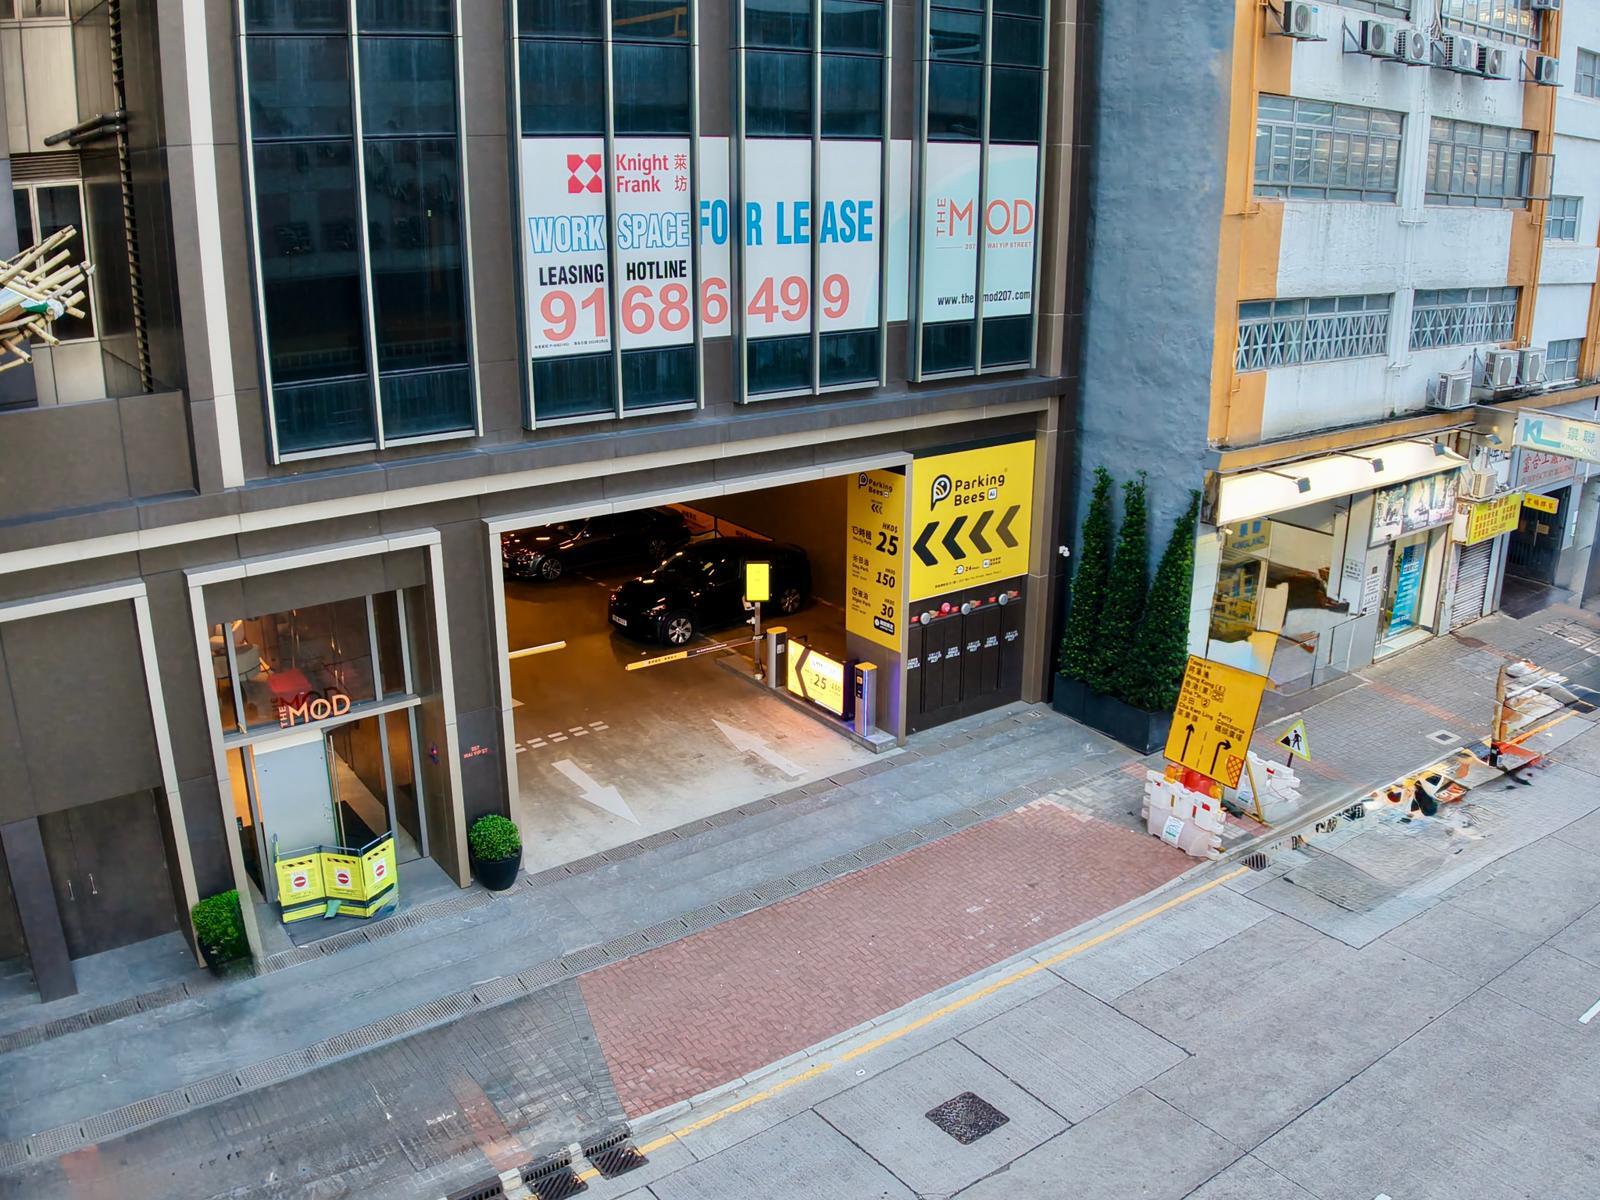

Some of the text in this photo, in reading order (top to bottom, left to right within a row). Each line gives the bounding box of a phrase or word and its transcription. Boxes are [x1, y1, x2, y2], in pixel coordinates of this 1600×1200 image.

[616, 154, 669, 175] Knight
[674, 154, 687, 192] 萊坊
[616, 176, 661, 192] Frank
[528, 215, 605, 253] WORK
[617, 212, 690, 250] SPACE
[776, 200, 873, 245] LEASE
[936, 198, 946, 236] THE
[949, 199, 1034, 236] MOD
[539, 260, 687, 286] LEASING HOTLINE
[868, 486, 883, 496] Bees
[869, 478, 893, 493] Parking
[955, 474, 1005, 491] Parking
[954, 492, 985, 506] Bees
[876, 531, 899, 556] 25
[876, 572, 895, 588] 150
[880, 603, 894, 618] 30
[814, 673, 827, 690] 25
[279, 706, 288, 729] THE
[288, 694, 351, 726] MOD
